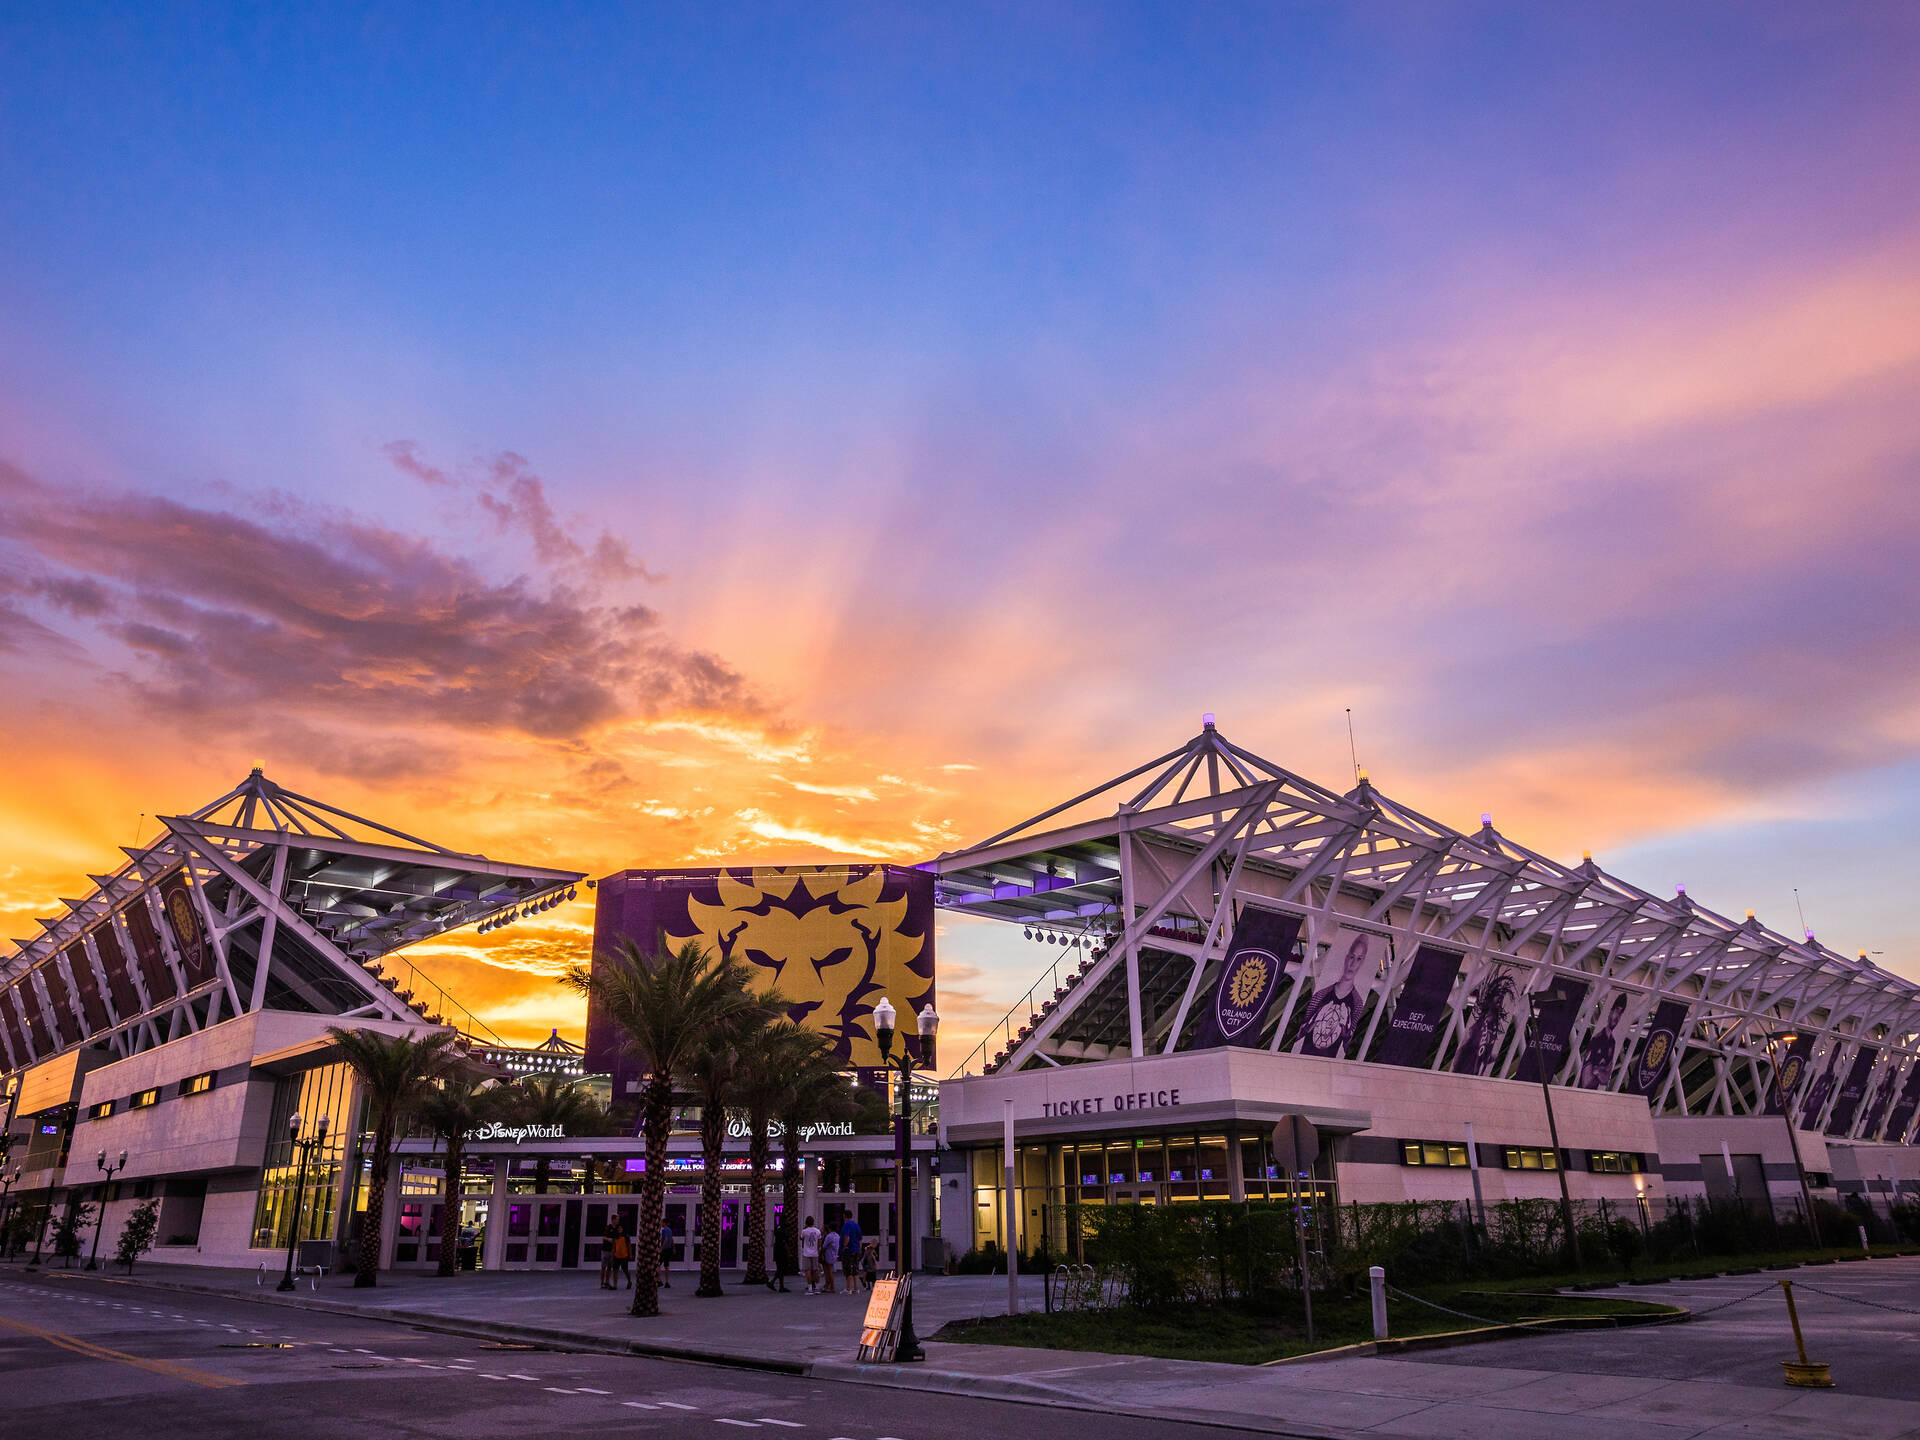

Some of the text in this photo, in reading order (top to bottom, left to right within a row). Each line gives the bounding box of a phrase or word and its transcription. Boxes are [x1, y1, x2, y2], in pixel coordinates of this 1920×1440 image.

[1221, 1008, 1252, 1020] ORLANDO
[1409, 1011, 1426, 1021] DEFY
[1226, 1017, 1242, 1026] CITY
[1392, 1019, 1434, 1033] EXPECTATIONS
[1043, 1089, 1180, 1118] TICKET OFFICE
[876, 1289, 891, 1302] ROAD
[868, 1306, 889, 1319] CLOSED
